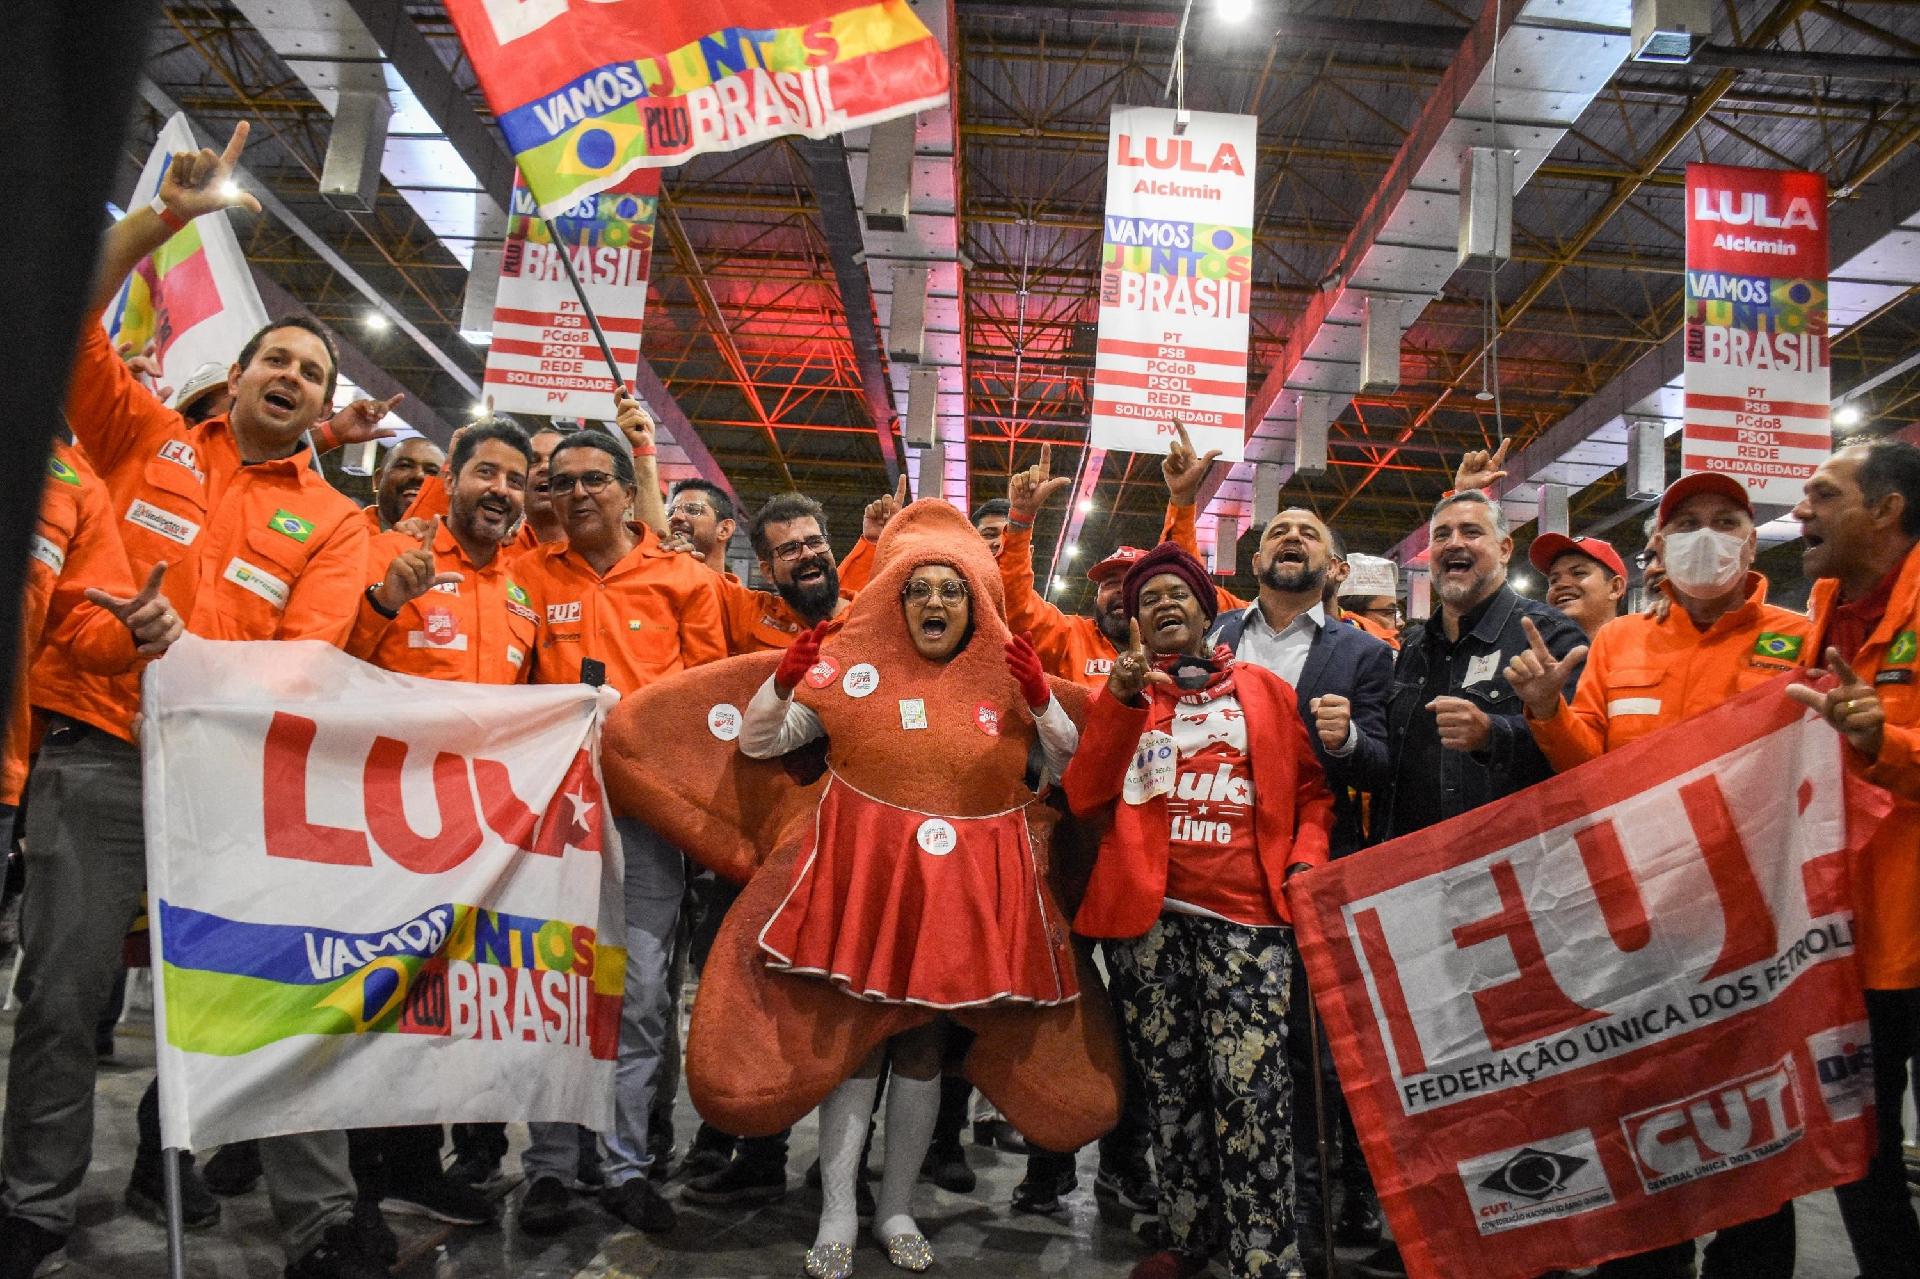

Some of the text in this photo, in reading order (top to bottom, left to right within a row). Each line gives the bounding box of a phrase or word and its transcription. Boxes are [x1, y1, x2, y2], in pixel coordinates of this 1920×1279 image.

[533, 65, 644, 137] VAMOS
[643, 65, 847, 148] PELO BRASIL
[1117, 133, 1245, 177] LULA
[1133, 178, 1221, 200] Alckmin
[1694, 187, 1819, 231] LULA
[1107, 217, 1190, 249] VAMOS
[1713, 233, 1796, 255] Alckmin
[521, 241, 648, 287] BRASIL
[1104, 245, 1251, 282] JUNTOS
[1103, 273, 1120, 303] PELO
[1121, 270, 1249, 319] BRASIL
[1689, 272, 1769, 305] VAMOS
[559, 301, 580, 312] PT
[553, 316, 581, 327] PSB
[541, 329, 590, 343] PCdoB
[1163, 331, 1183, 343] PT
[541, 345, 585, 359] PSOL
[1157, 347, 1186, 359] PSB
[1704, 325, 1829, 373] BRASIL
[540, 360, 584, 374] REDE
[1146, 360, 1196, 376] PCdoB
[506, 372, 614, 391] SOLIDARIEDADE
[1148, 375, 1192, 392] PSOL
[547, 391, 568, 403] PV
[1147, 391, 1191, 407] REDE
[1747, 386, 1767, 399] PT
[1114, 404, 1223, 425] SOLIDARIEDADE
[1744, 402, 1771, 414] PSB
[1156, 423, 1178, 436] PV
[1735, 413, 1782, 429] PCdoB
[1737, 430, 1780, 446] PSOL
[1737, 445, 1780, 460] REDE
[1706, 459, 1812, 477] SOLIDARIEDADE
[1747, 477, 1768, 489] PV
[546, 602, 581, 621] FUP
[1167, 763, 1255, 806] ula
[1170, 815, 1232, 844] Livre
[304, 907, 449, 980] VAMOS
[447, 959, 591, 1051] BRASIL
[1403, 1038, 1579, 1107] FEDERAÇÃO
[1586, 1007, 1688, 1055] ÚNICA
[1690, 975, 1759, 1020] DOS
[1636, 1068, 1790, 1175] CUT
[1646, 1170, 1694, 1191] CENTRAL
[1729, 1151, 1752, 1165] DOS
[1480, 1201, 1509, 1217] CUT
